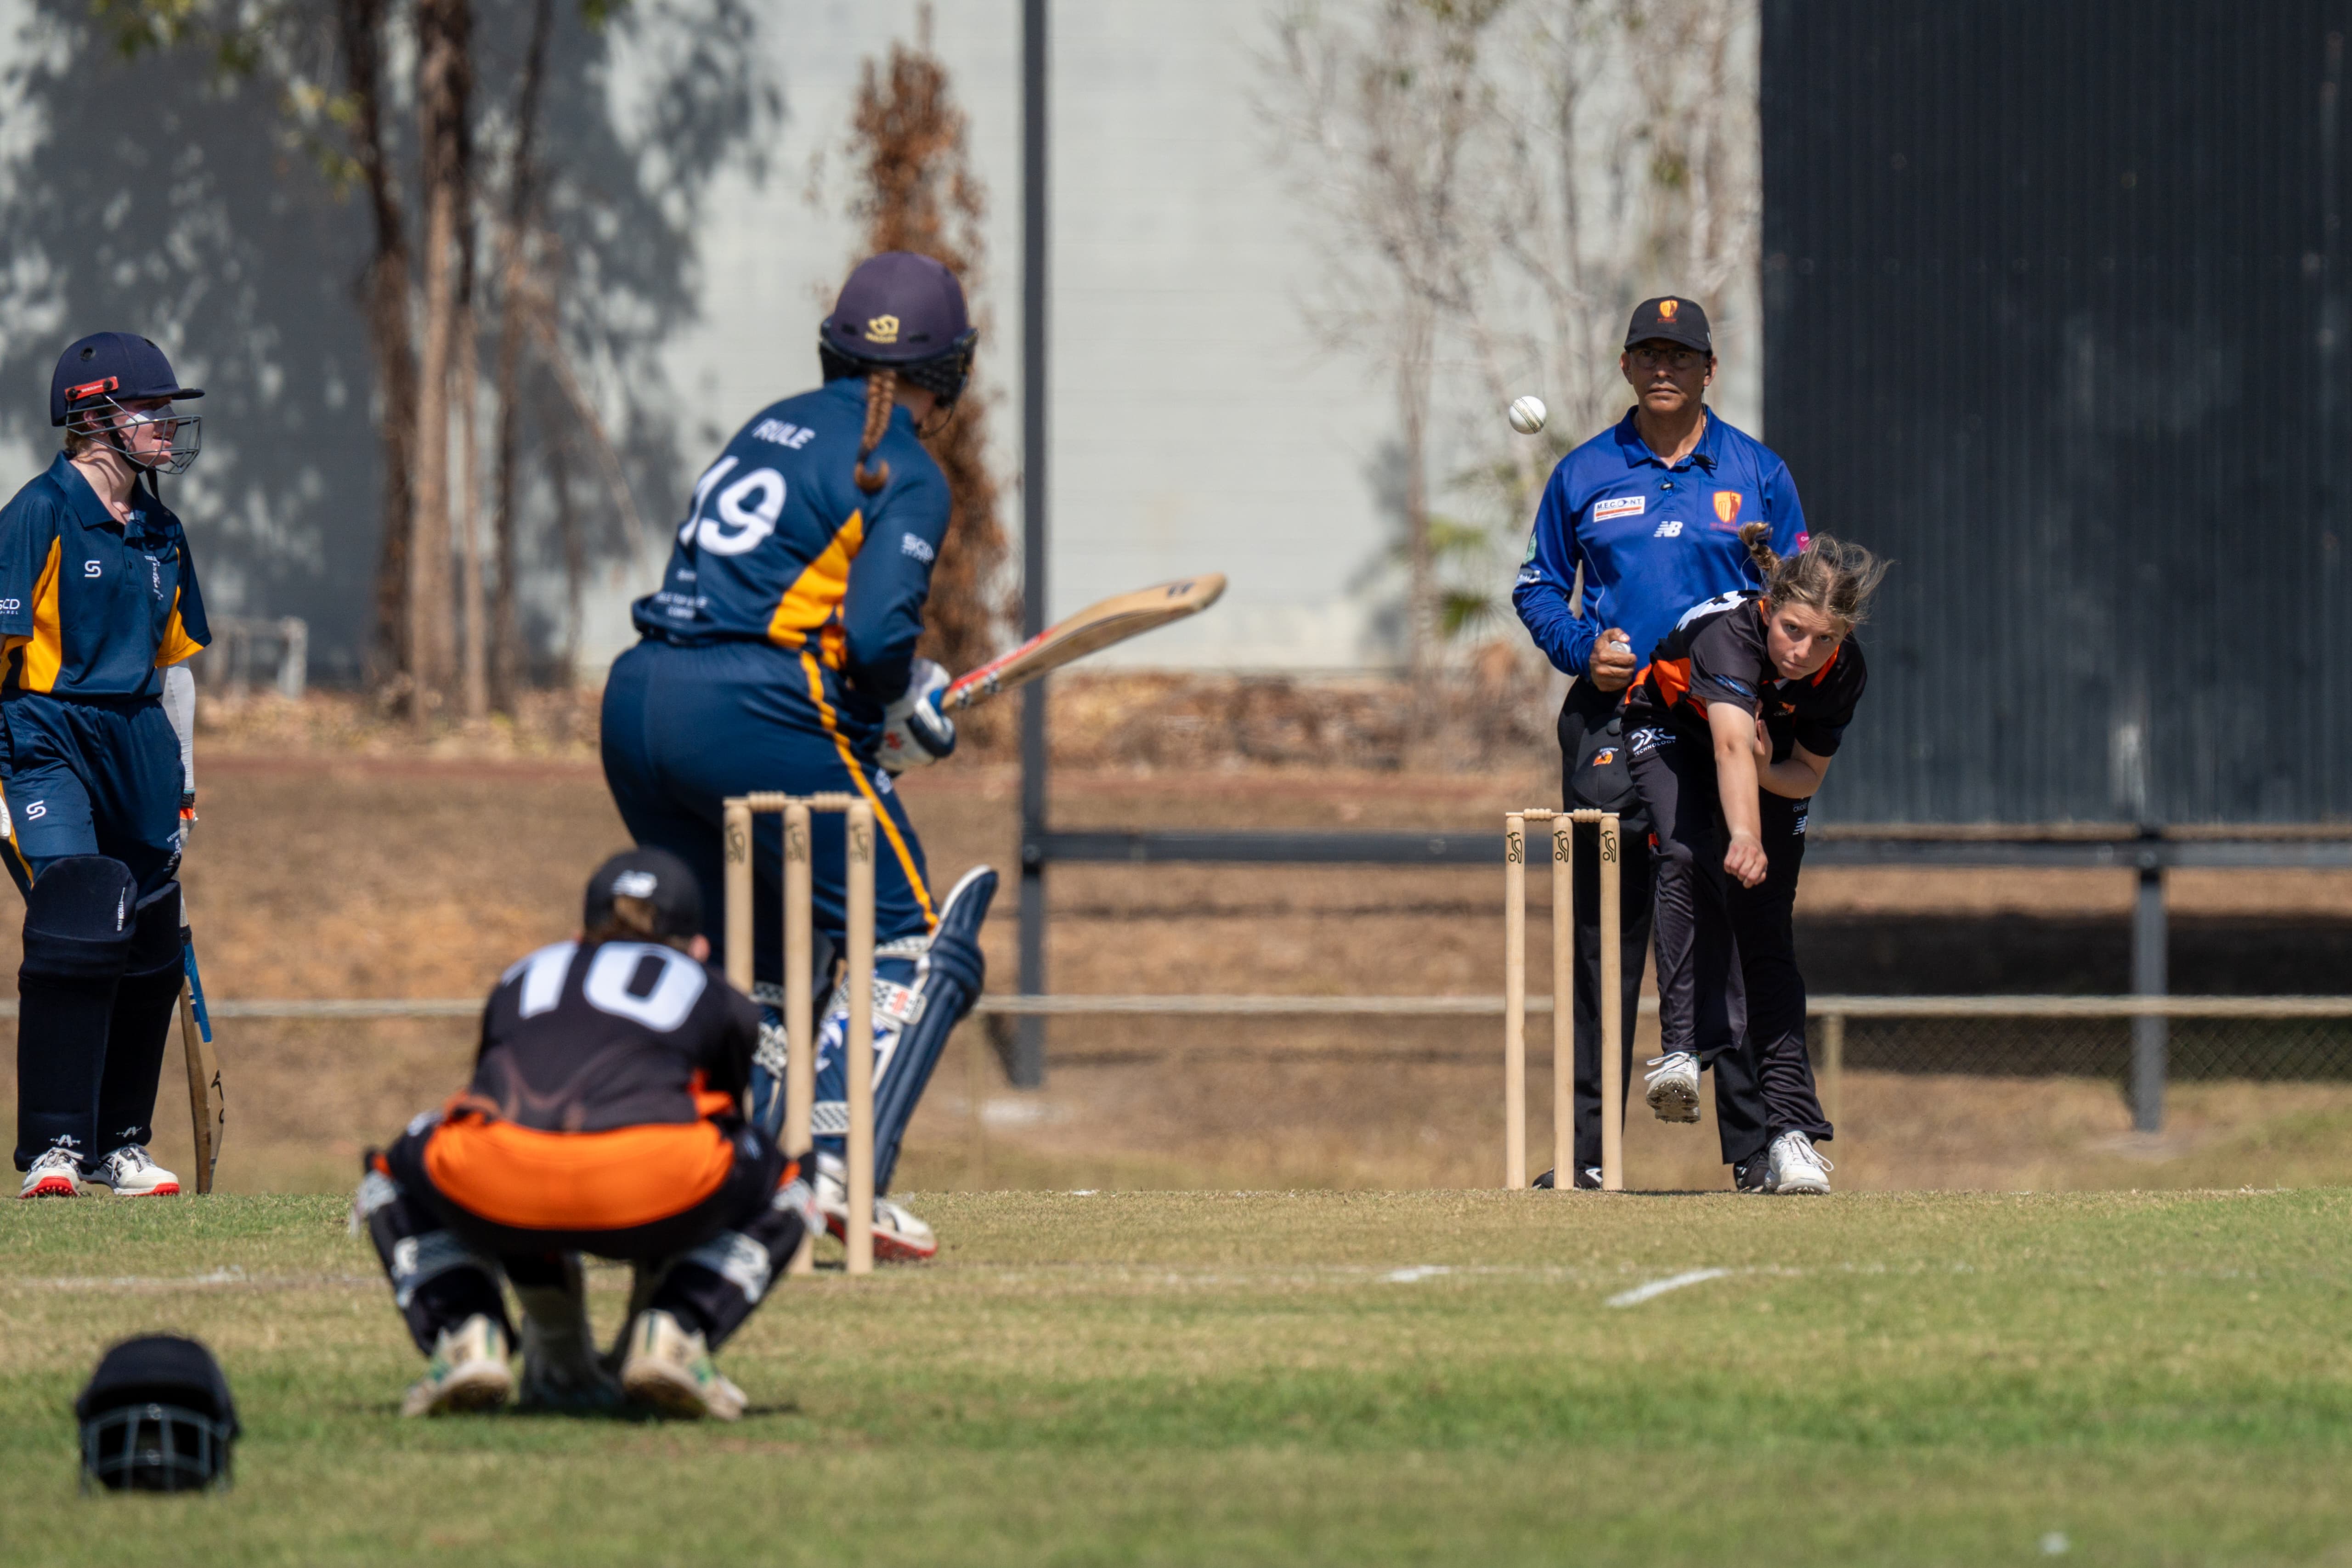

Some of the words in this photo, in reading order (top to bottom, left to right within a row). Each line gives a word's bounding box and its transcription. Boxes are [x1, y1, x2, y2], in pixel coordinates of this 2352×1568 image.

[752, 418, 815, 446] RULE
[678, 455, 787, 556] 19
[501, 940, 708, 1033] 10
